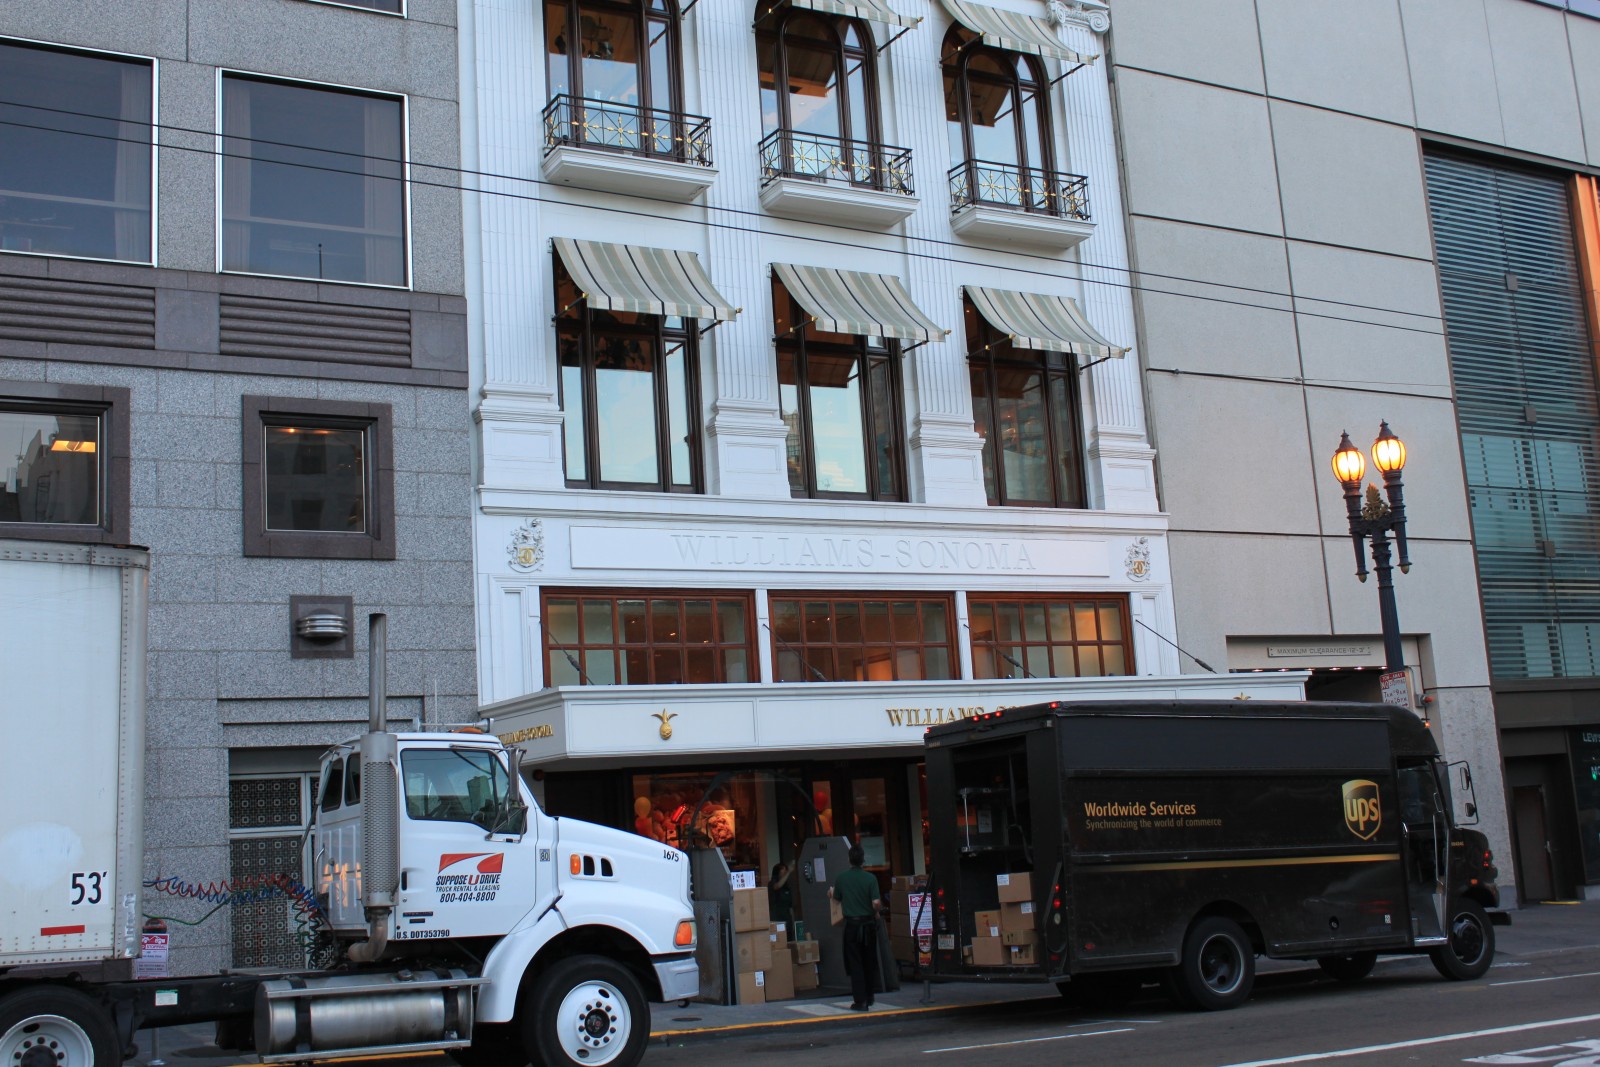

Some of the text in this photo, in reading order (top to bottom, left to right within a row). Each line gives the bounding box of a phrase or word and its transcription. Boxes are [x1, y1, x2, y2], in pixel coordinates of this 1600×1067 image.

[670, 534, 1037, 570] WILLIAMS-SONOMA
[1084, 801, 1197, 816] Worldwide Services
[1346, 797, 1379, 831] ups
[1086, 818, 1222, 831] Synchronizing the world of commerce
[663, 849, 680, 862] 1675
[436, 874, 501, 886] SUPPOSE U DRIVE
[440, 891, 496, 903] 800-404-8800
[396, 929, 450, 939] U.S. DOT353790
